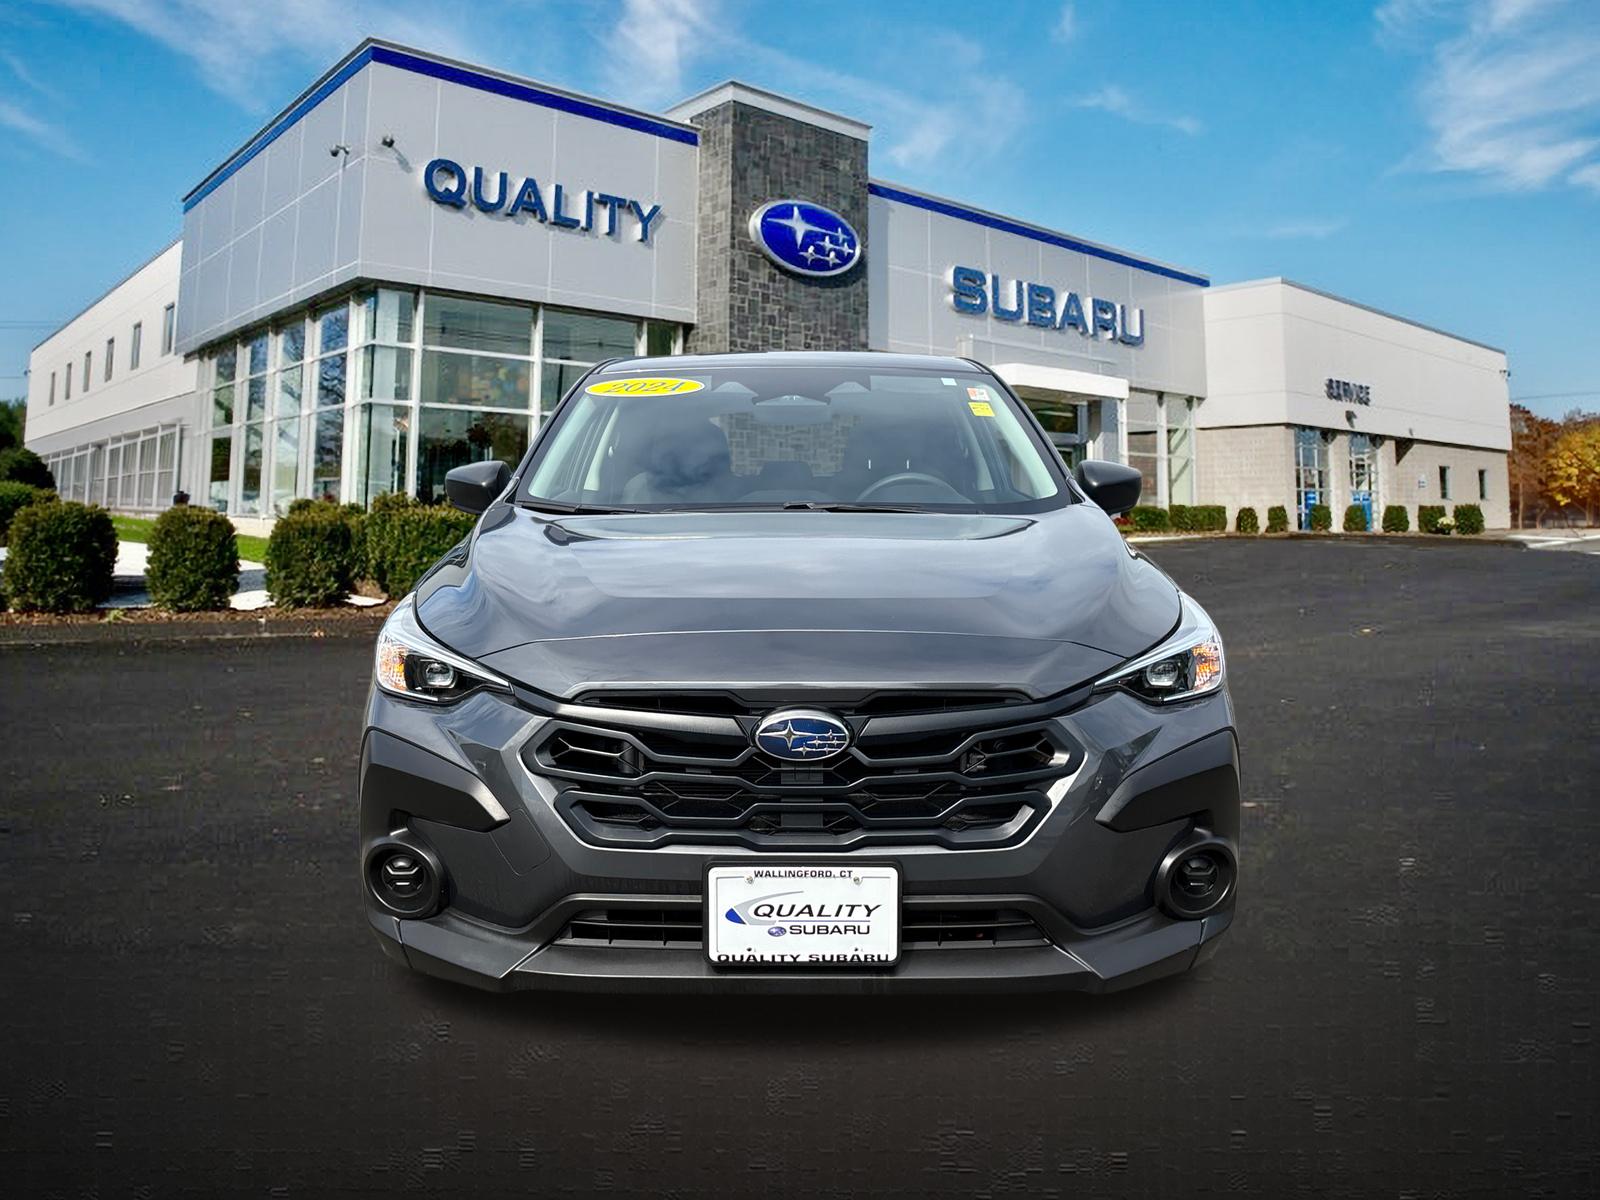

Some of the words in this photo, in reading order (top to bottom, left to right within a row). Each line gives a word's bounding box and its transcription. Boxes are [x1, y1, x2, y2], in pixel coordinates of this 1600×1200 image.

[424, 158, 662, 243] QUALITY
[951, 265, 1145, 346] SUBARU
[604, 381, 686, 393] 2024
[1324, 377, 1371, 407] SERVICE
[839, 869, 854, 878] CT
[753, 904, 882, 918] QUALITY
[789, 925, 871, 935] SUBARU
[717, 953, 801, 963] QUALITY
[808, 953, 890, 963] SUBARU
